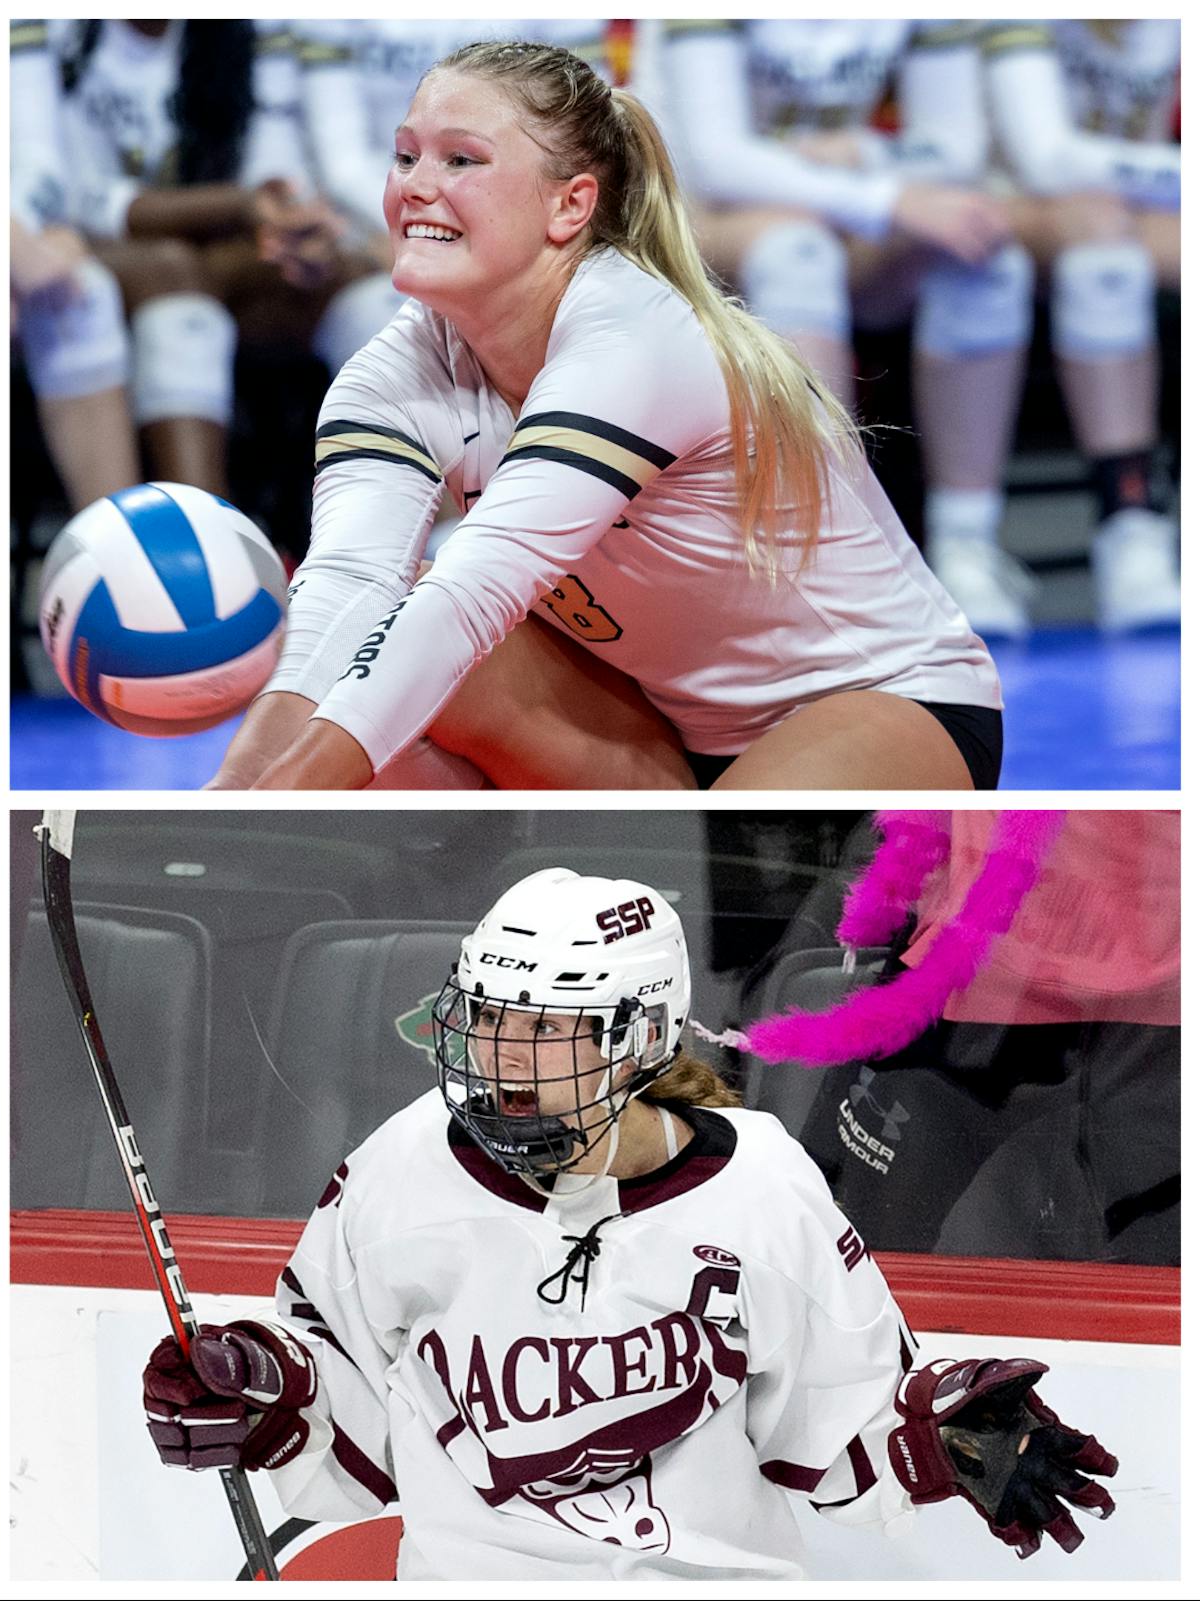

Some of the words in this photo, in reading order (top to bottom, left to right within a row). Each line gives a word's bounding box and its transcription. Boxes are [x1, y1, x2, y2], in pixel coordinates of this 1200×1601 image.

[596, 896, 655, 945] SSP
[479, 953, 538, 973] CCM
[637, 977, 673, 997] CCM
[486, 1139, 528, 1154] AUER
[837, 1117, 889, 1175] RMOUR
[840, 1098, 896, 1162] UNDER
